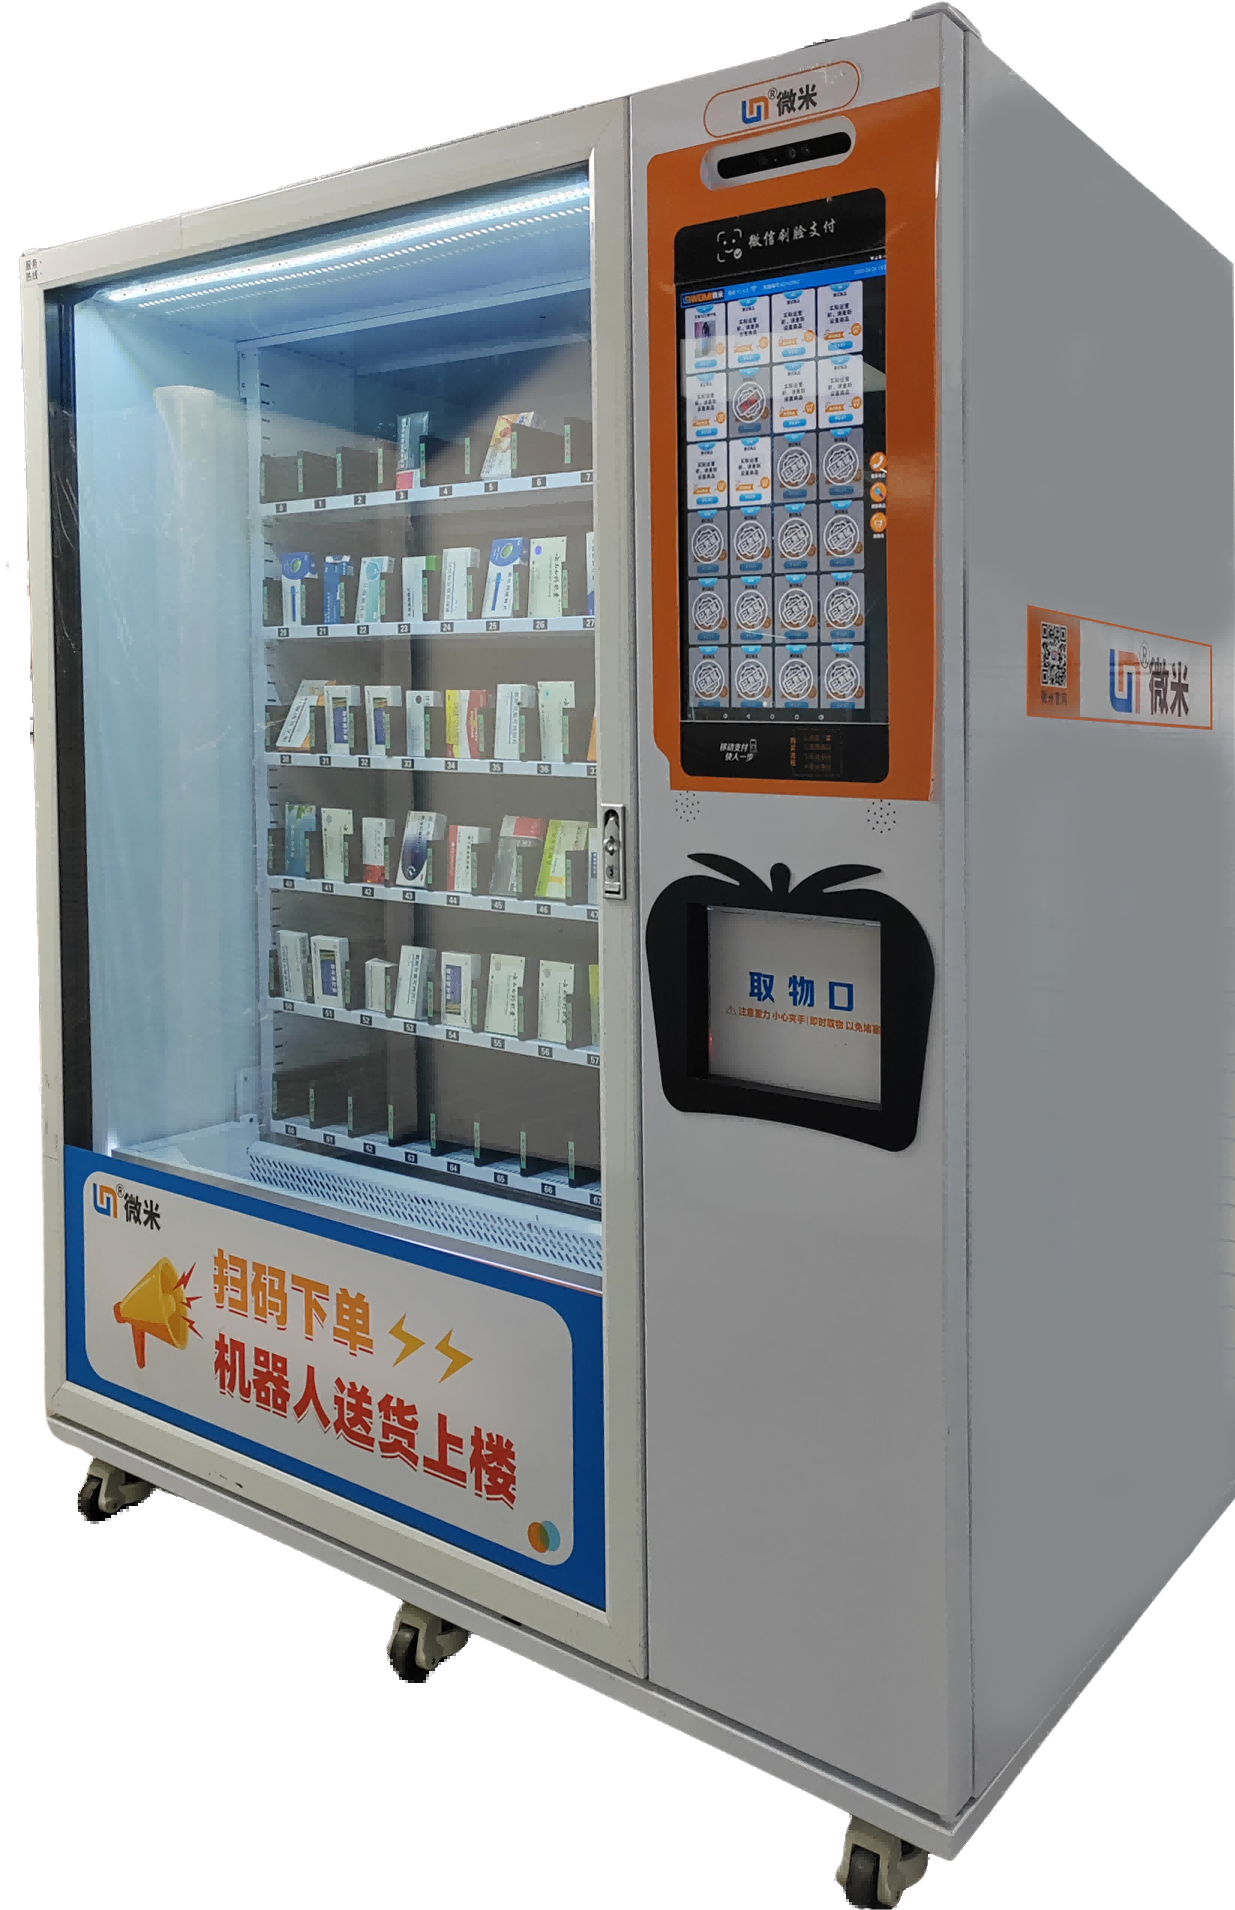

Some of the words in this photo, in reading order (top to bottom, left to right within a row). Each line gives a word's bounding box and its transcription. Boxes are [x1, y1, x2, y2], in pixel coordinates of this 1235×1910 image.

[776, 84, 817, 116] 微米
[748, 218, 836, 248] 微信刷脸支付
[489, 622, 497, 630] 25
[536, 620, 545, 629] 26
[586, 618, 595, 628] 27
[1149, 657, 1189, 717] 微米
[719, 743, 748, 752] 移动支付
[725, 753, 753, 762] 快人一步
[540, 765, 549, 773] 36
[539, 906, 548, 914] 46
[749, 971, 854, 1012] 取物口
[448, 1031, 456, 1039] 54
[494, 1039, 502, 1047] 55
[541, 1047, 550, 1056] 56
[590, 1056, 599, 1064] 57
[544, 1185, 553, 1194] 66
[593, 1196, 602, 1205] 67
[124, 1193, 161, 1231] 微米
[214, 1248, 374, 1355] 扫码下单
[214, 1334, 517, 1509] 机器人送货上楼
